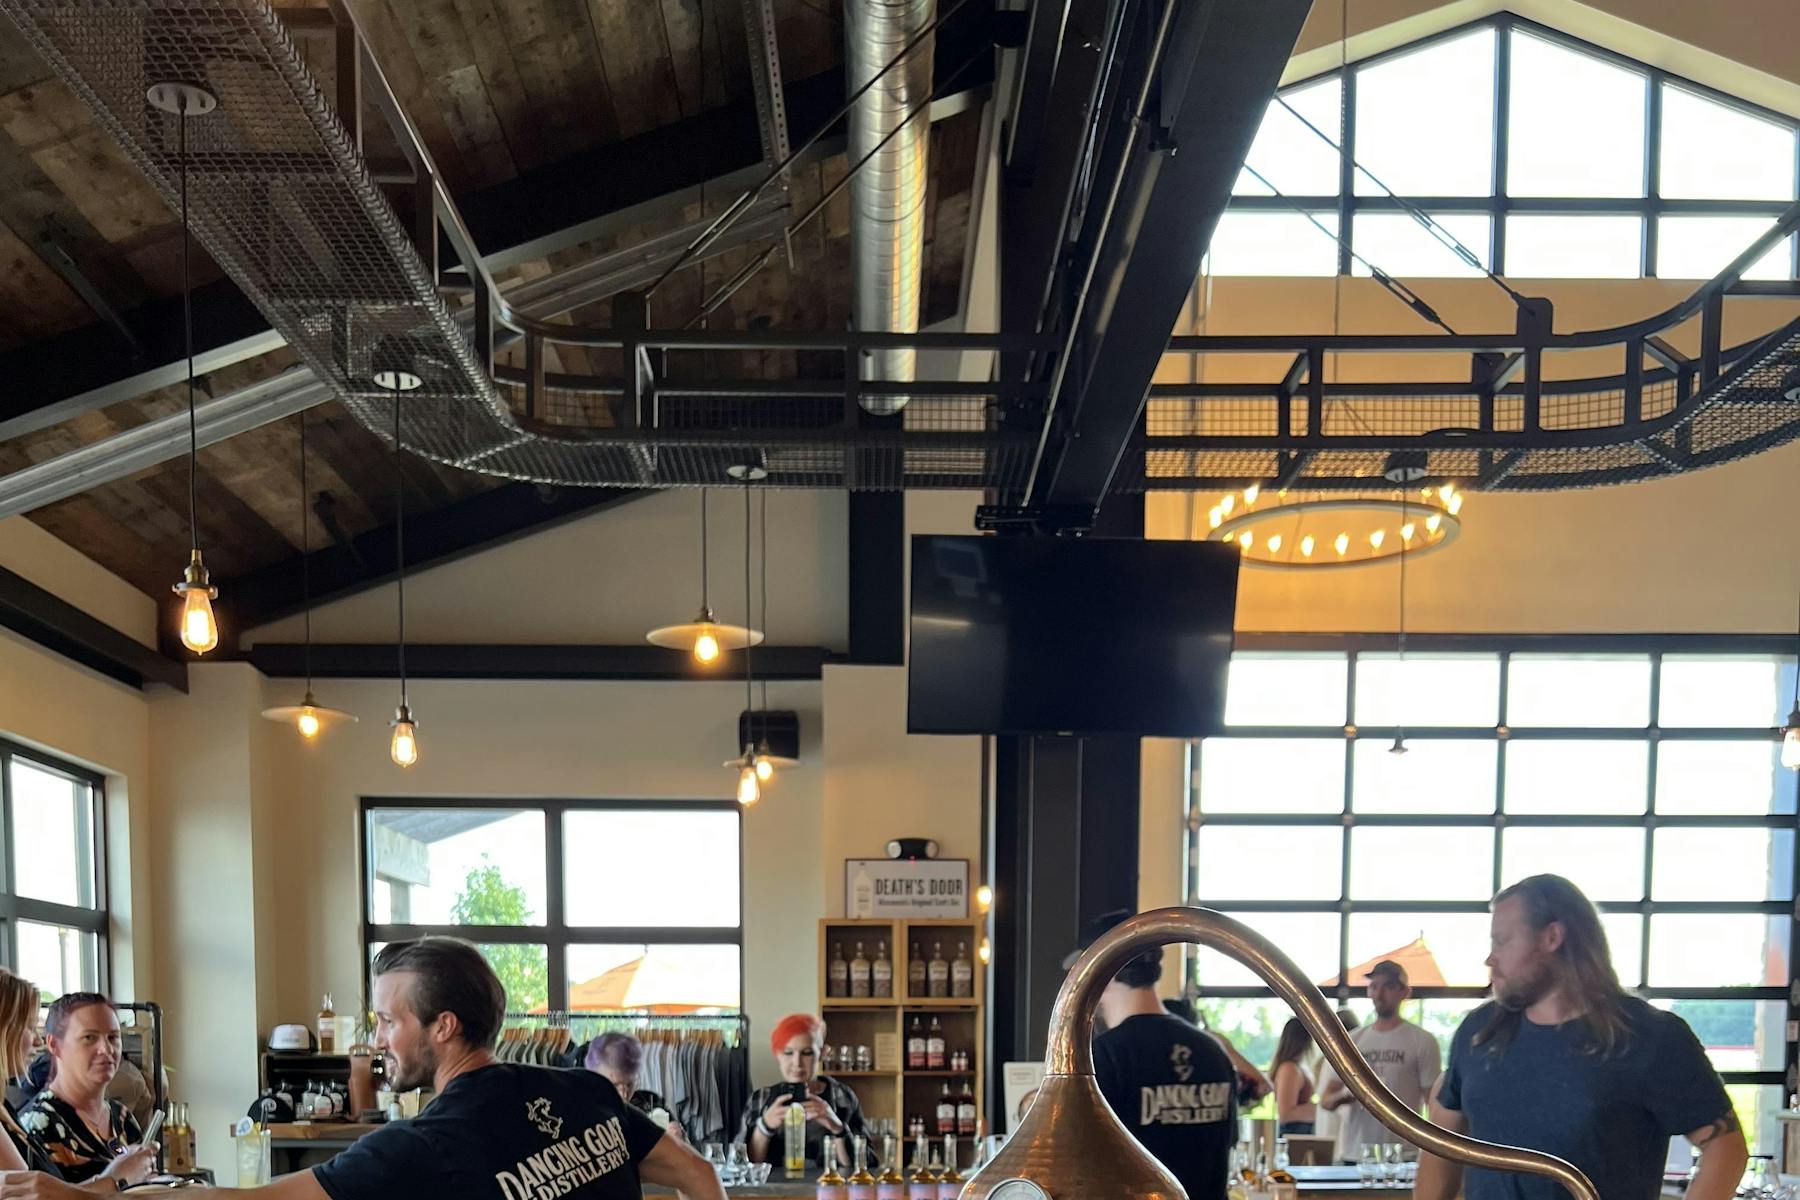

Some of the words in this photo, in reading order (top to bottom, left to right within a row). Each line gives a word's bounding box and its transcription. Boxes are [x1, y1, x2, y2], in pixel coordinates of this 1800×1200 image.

[875, 878, 925, 896] DEATH'S
[930, 878, 963, 896] DOOR
[583, 1116, 630, 1160] GOAT
